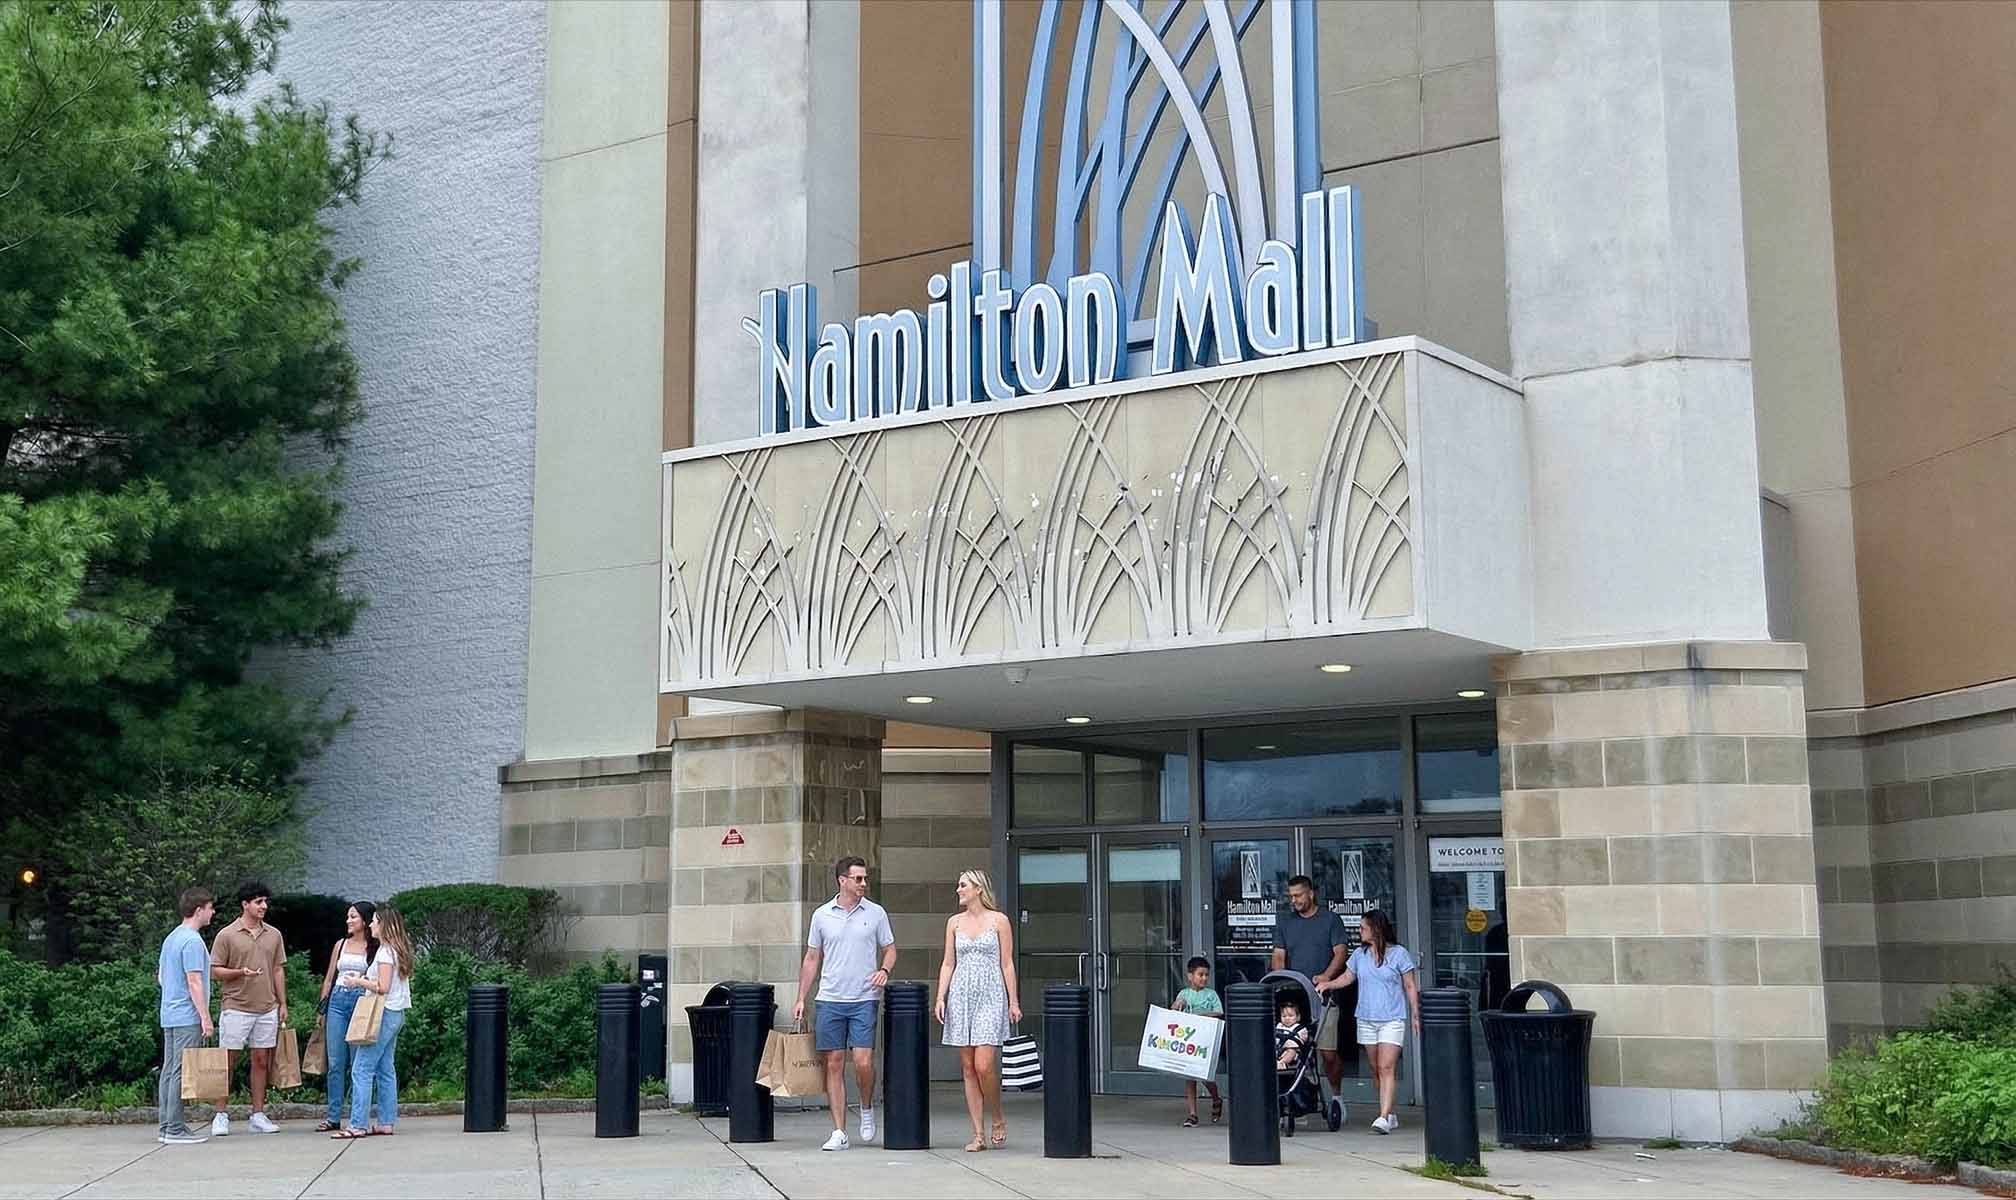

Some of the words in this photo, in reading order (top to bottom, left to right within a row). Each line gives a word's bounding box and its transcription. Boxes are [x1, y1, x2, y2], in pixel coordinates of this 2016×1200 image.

[740, 260, 1126, 436] Hamilton
[1151, 184, 1362, 376] Mall
[1438, 847, 1487, 856] WELCOME
[1491, 847, 1504, 855] TO
[1227, 899, 1260, 914] Hamilton
[1261, 899, 1277, 913] Mall
[1328, 899, 1362, 914] Hamilton
[1363, 899, 1380, 913] Mall
[1167, 1023, 1196, 1041] TOY
[1147, 1033, 1208, 1059] KINGDOM
